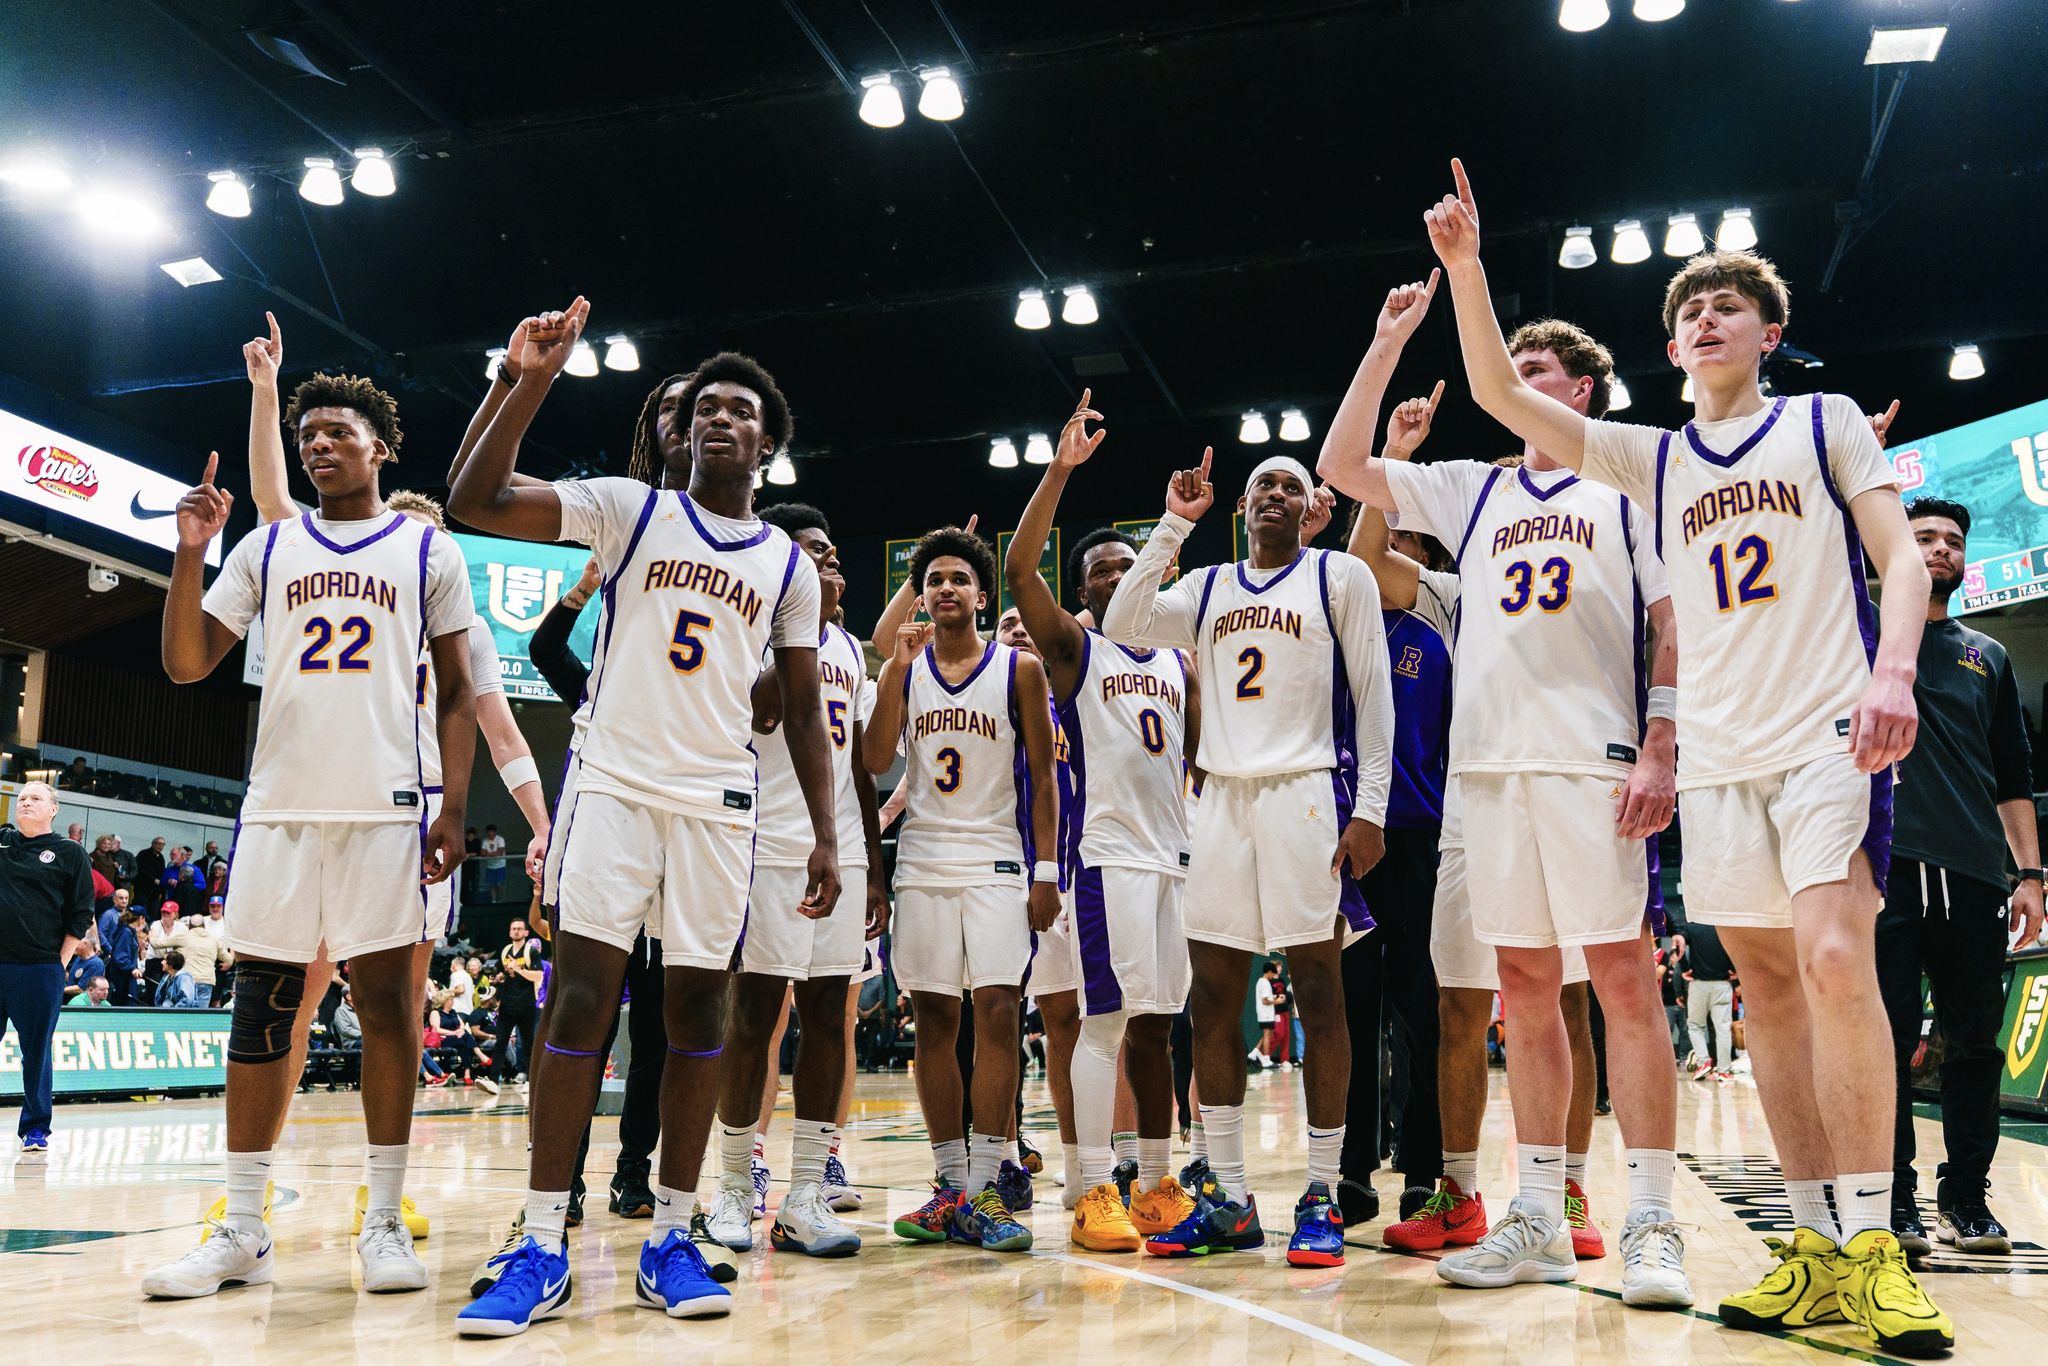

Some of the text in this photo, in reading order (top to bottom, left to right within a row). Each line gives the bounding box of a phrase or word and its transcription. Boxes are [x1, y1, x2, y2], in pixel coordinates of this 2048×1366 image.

[1681, 478, 1803, 546] RIORDAN
[1491, 514, 1594, 559] RIORDAN
[285, 571, 397, 614] RIORDAN
[643, 559, 763, 628] RIORDAN
[1500, 556, 1574, 616] 33
[1708, 532, 1779, 613] 12
[2002, 561, 2022, 581] 51
[299, 615, 375, 673] 22
[667, 607, 715, 676] 5
[1213, 605, 1303, 645] RIORDAN
[820, 661, 854, 699] DAN
[1236, 645, 1266, 702] 2
[1397, 645, 1423, 674] R
[1962, 643, 1983, 669] R
[1102, 672, 1181, 714] RIORDAN
[914, 707, 997, 742] RIORDAN
[1137, 707, 1167, 758] 0
[934, 745, 963, 796] 3
